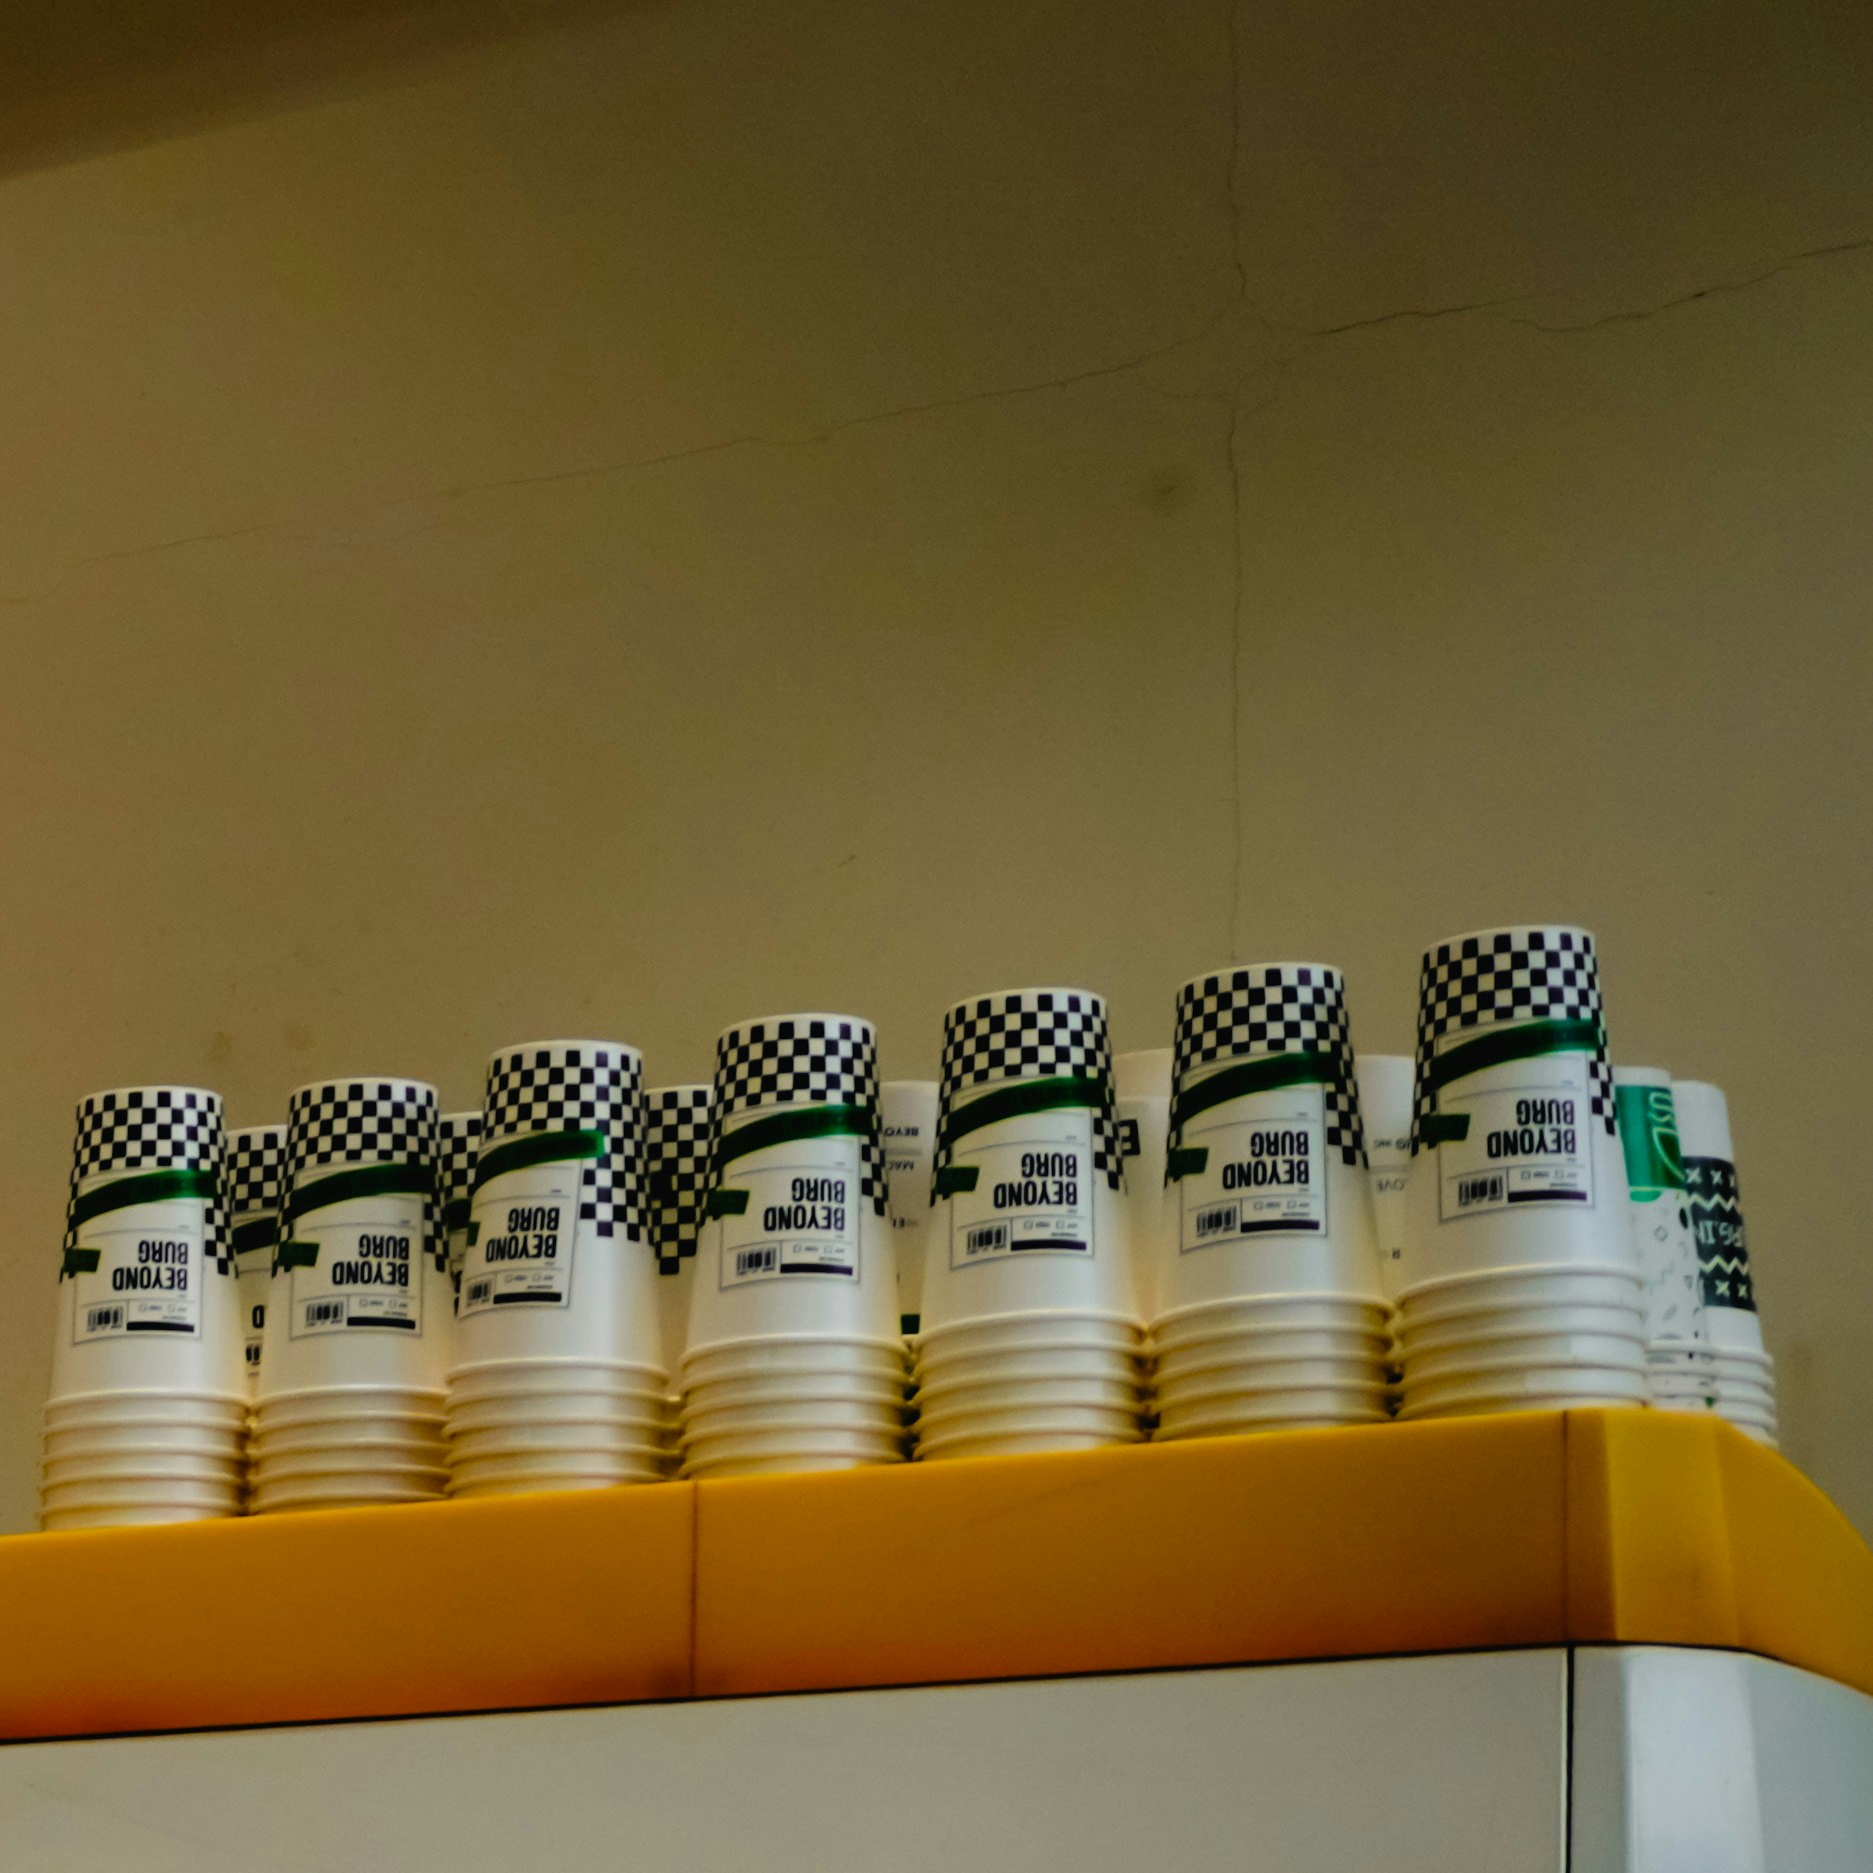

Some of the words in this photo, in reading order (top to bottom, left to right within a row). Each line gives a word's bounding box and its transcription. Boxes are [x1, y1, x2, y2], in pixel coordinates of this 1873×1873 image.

[1516, 1099, 1574, 1127] BURG
[1251, 1130, 1309, 1158] BURG
[1487, 1127, 1575, 1159] BEYOND
[1021, 1152, 1077, 1179] BURG
[1223, 1159, 1309, 1190] BEYOND
[792, 1177, 845, 1204] BURG
[994, 1180, 1077, 1209] BEYOND
[507, 1206, 560, 1235] BURG
[763, 1204, 845, 1232] BEYOND
[138, 1239, 188, 1265] BURG
[358, 1234, 410, 1261] BURG
[485, 1233, 558, 1263] BEYOND
[112, 1265, 188, 1292] BEYOND
[332, 1260, 409, 1288] BEYOND
